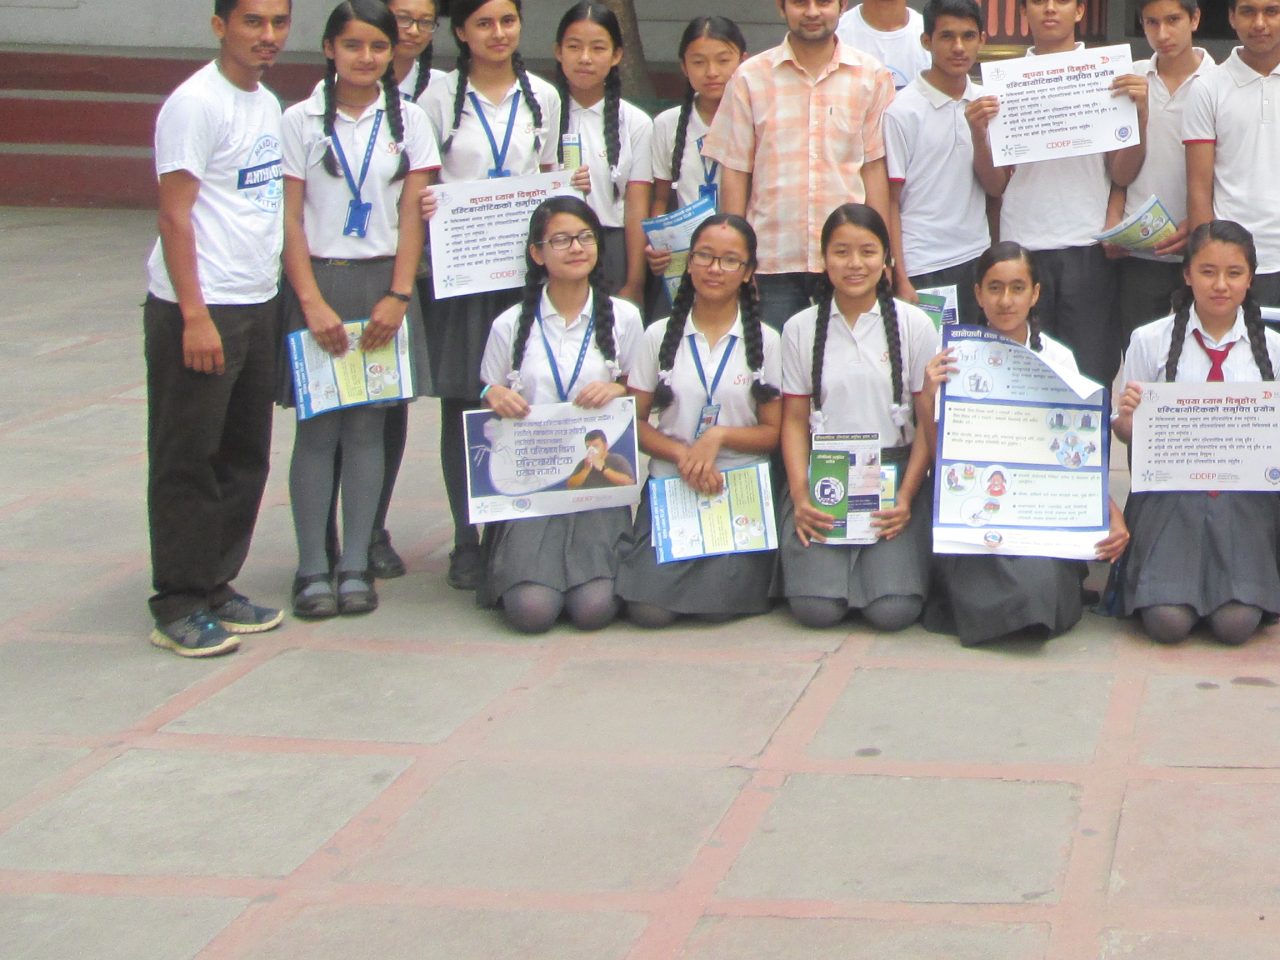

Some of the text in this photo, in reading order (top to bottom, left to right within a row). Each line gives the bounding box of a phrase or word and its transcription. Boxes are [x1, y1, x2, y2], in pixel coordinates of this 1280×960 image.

[1022, 70, 1044, 80] कृपया
[1046, 68, 1064, 76] ध्यान
[1094, 70, 1115, 79] प्रयोग
[1046, 140, 1072, 150] CDDEP
[470, 196, 492, 205] कृपया
[495, 194, 514, 202] ध्यान
[490, 270, 517, 280] CDDEP
[951, 329, 982, 338] खानेपानी
[1176, 397, 1200, 406] कृपया
